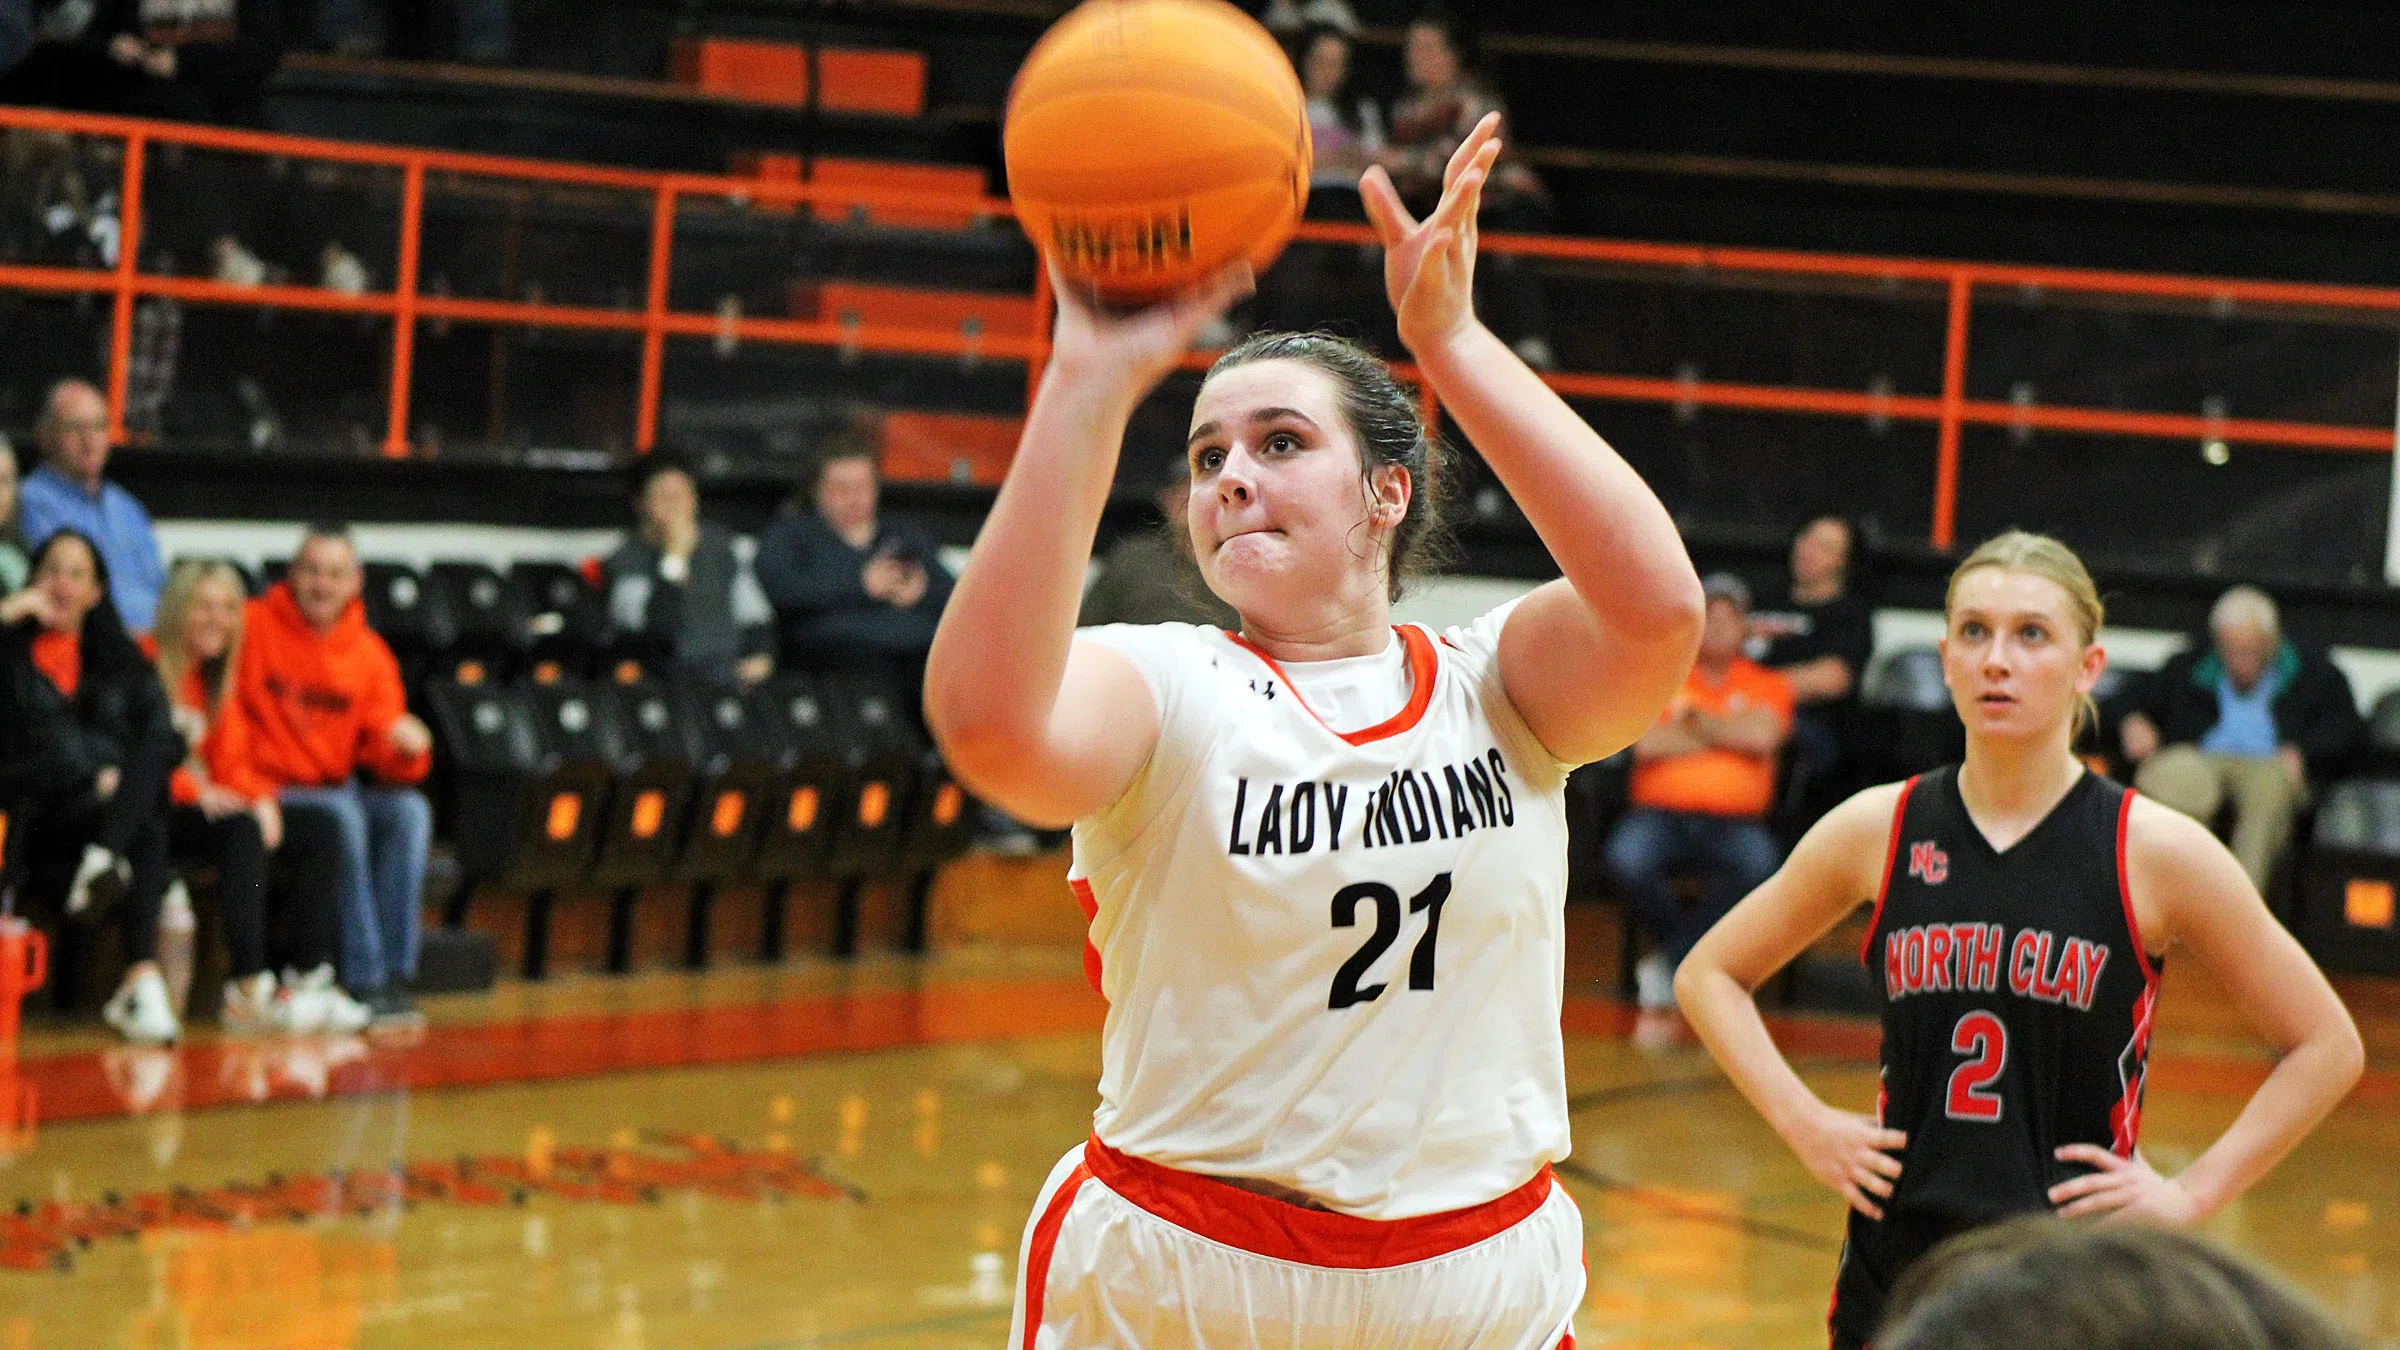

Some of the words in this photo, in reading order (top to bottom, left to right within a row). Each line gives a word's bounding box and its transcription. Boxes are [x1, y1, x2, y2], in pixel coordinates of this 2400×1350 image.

[1229, 776, 1348, 857] LADY
[1362, 747, 1515, 849] INDIANS
[1907, 840, 1949, 886] NC
[1327, 870, 1453, 1011] 21
[1884, 921, 2004, 1002] NORTH
[2007, 926, 2109, 1012] CLAY
[1944, 1008, 2007, 1124] 2
